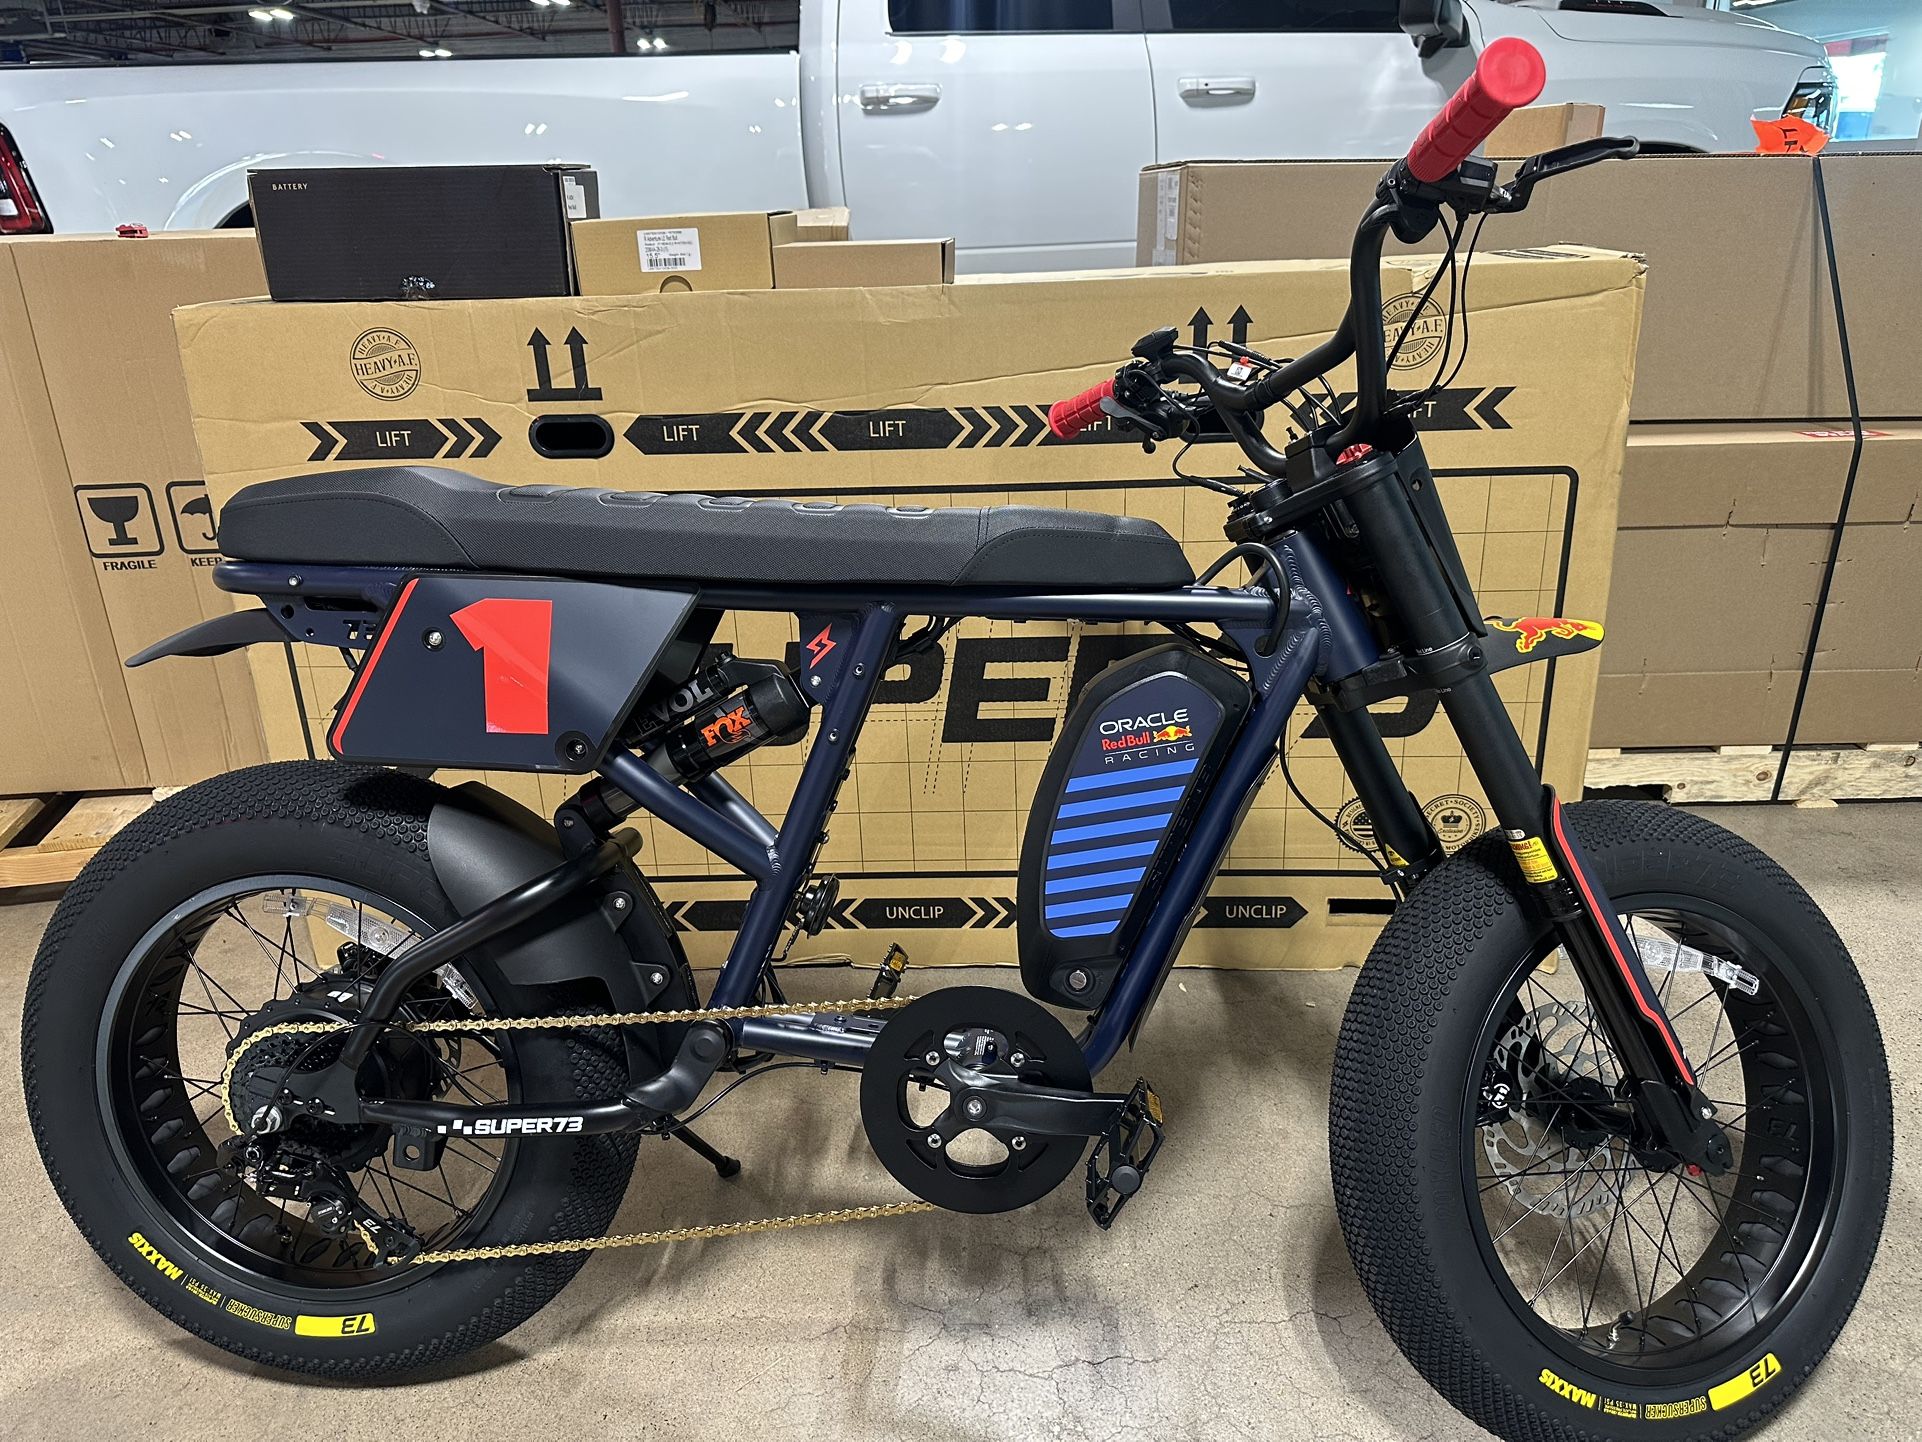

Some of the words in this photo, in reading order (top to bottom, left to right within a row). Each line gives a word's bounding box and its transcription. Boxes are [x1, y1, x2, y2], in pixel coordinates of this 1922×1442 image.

[271, 183, 308, 191] BATTERY
[354, 356, 394, 376] HEAVY
[663, 425, 700, 442] LIFT
[869, 420, 907, 437] LIFT
[376, 431, 412, 447] LIFT
[102, 559, 158, 571] FRAGILE
[449, 598, 553, 735] 1
[700, 706, 753, 748] FOX
[1100, 708, 1189, 735] ORACLE
[1101, 737, 1126, 751] Red
[1127, 731, 1151, 746] Bull
[1104, 743, 1195, 765] RACING
[1453, 800, 1481, 820] SOCIETY
[885, 905, 944, 919] UNCLIP
[1225, 905, 1287, 918] UNCLIP
[474, 1116, 584, 1135] SUPER73
[127, 1232, 184, 1281] MAXXIS
[226, 1299, 293, 1330] SUPERSUCKER
[341, 1315, 371, 1335] 73
[1750, 1357, 1776, 1388] 73
[1539, 1368, 1597, 1409] MAXXIS
[1645, 1396, 1707, 1420] SUPERSUCKER
